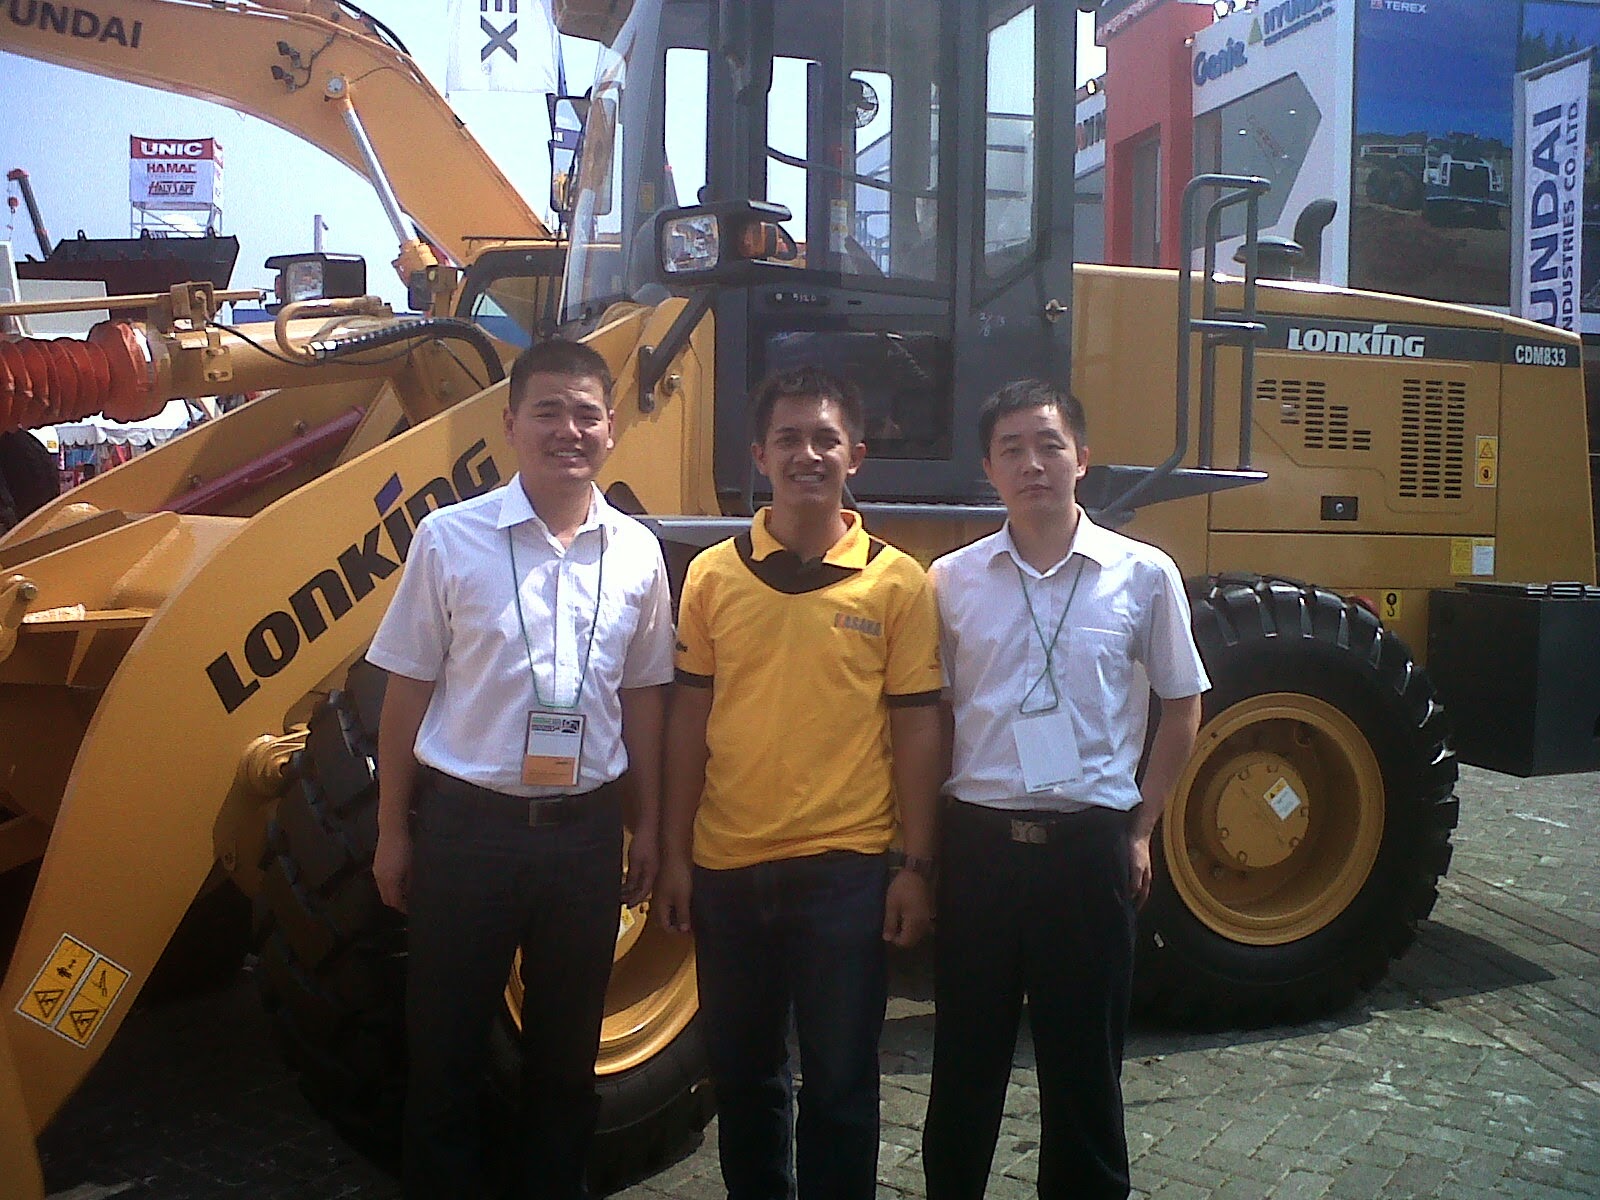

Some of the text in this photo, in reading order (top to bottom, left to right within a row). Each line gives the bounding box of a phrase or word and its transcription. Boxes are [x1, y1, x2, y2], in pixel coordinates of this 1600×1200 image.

[1385, 0, 1427, 13] TEREX
[6, 0, 142, 48] UNDAI
[1194, 37, 1248, 86] Genie
[141, 141, 203, 156] UNIC
[1515, 345, 1567, 366] CDM833
